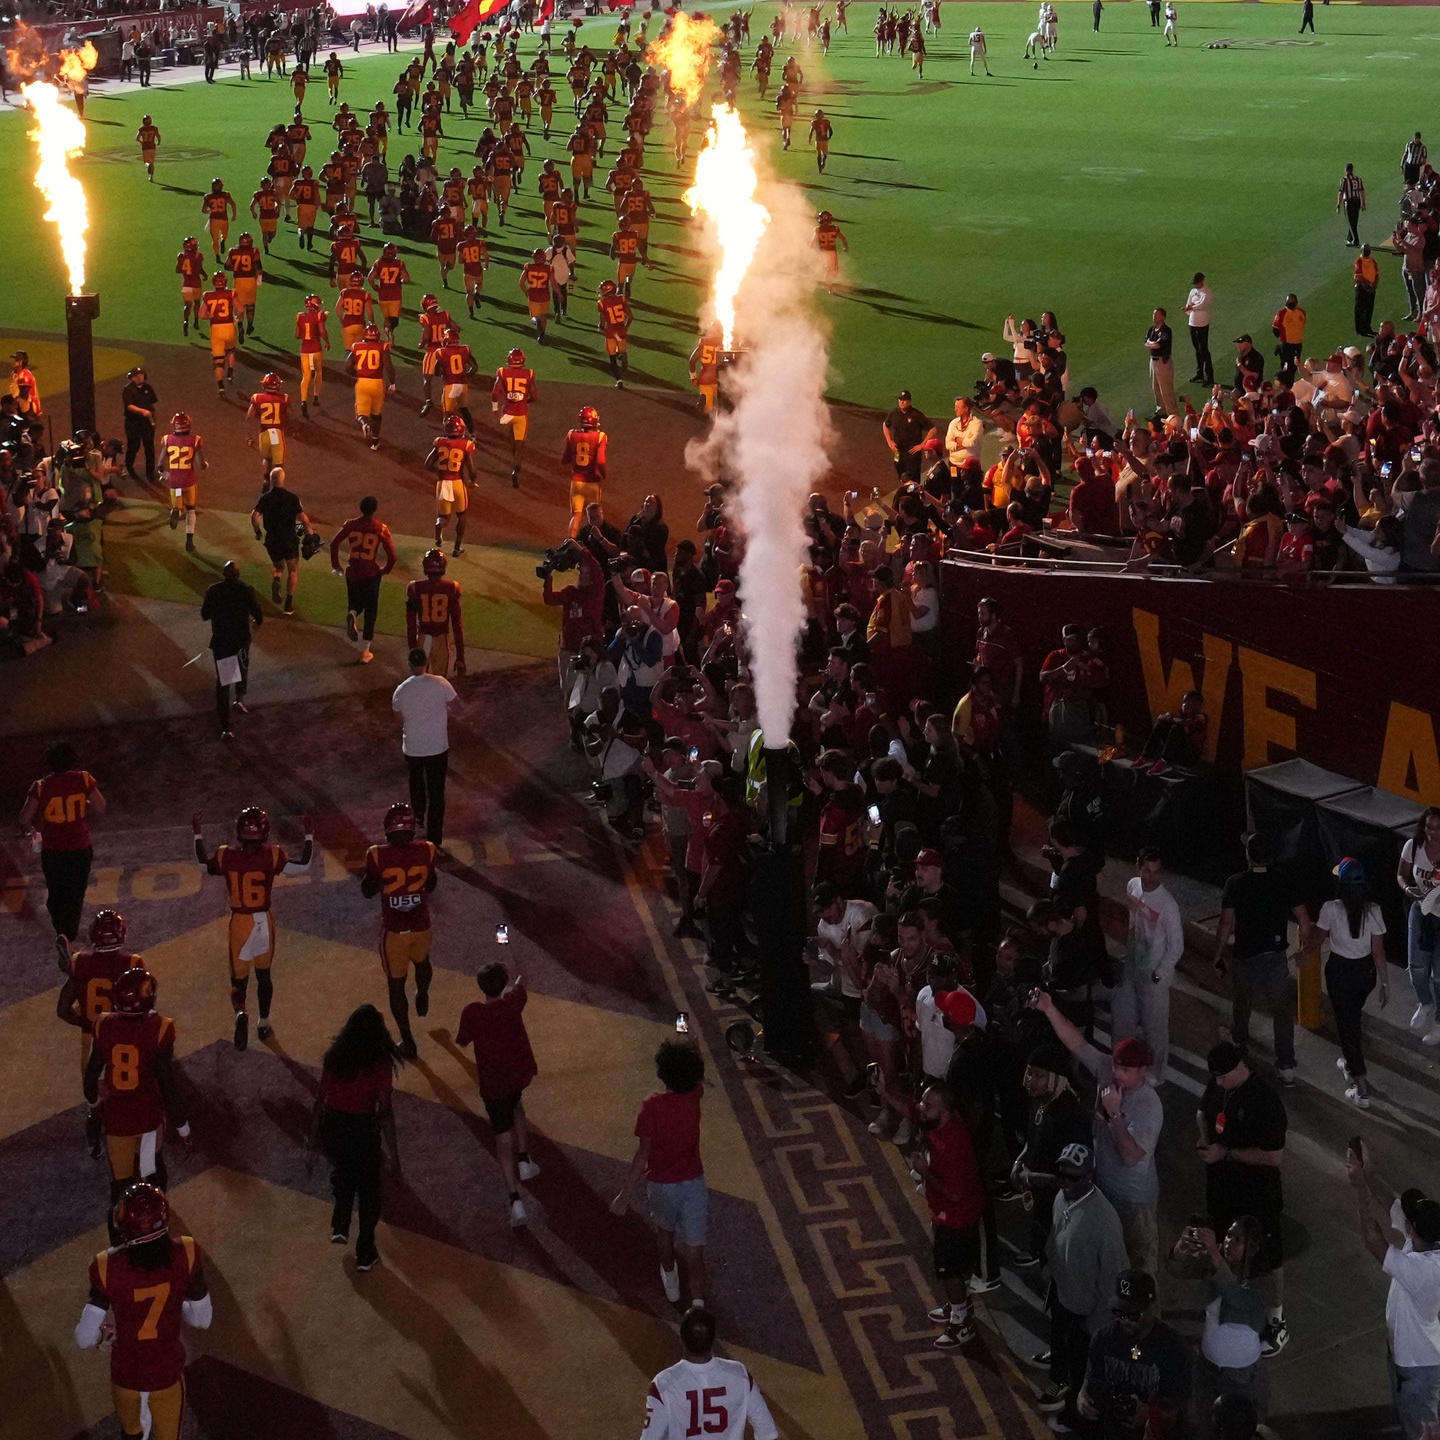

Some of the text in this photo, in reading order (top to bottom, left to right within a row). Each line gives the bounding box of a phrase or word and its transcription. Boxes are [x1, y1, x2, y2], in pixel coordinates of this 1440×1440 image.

[176, 13, 203, 24] STAR
[296, 185, 311, 199] 78
[543, 177, 556, 191] 26
[209, 197, 226, 212] 39
[260, 196, 275, 210] 46
[555, 209, 569, 224] 19
[440, 224, 455, 238] 31
[462, 246, 481, 263] 48
[619, 238, 637, 254] 89
[231, 254, 252, 271] 79
[341, 247, 357, 264] 41
[181, 259, 192, 275] 4
[379, 267, 399, 284] 47
[527, 271, 549, 289] 52
[207, 298, 230, 317] 73
[344, 298, 364, 315] 98
[606, 306, 625, 323] 15
[304, 323, 311, 340] 1
[356, 349, 381, 370] 70
[450, 353, 464, 374] 0
[505, 378, 527, 394] 15
[260, 401, 281, 425] 21
[167, 445, 194, 470] 22
[437, 446, 465, 472] 28
[575, 441, 591, 467] 8
[347, 530, 379, 561] 29
[420, 593, 450, 624] 18
[44, 794, 88, 823] 40
[381, 864, 429, 895] 22
[228, 870, 267, 909] 16
[390, 893, 422, 908] USC
[86, 978, 113, 1020] 6
[111, 1044, 141, 1092] 8
[133, 1281, 171, 1341] 7
[685, 1386, 729, 1438] 15
